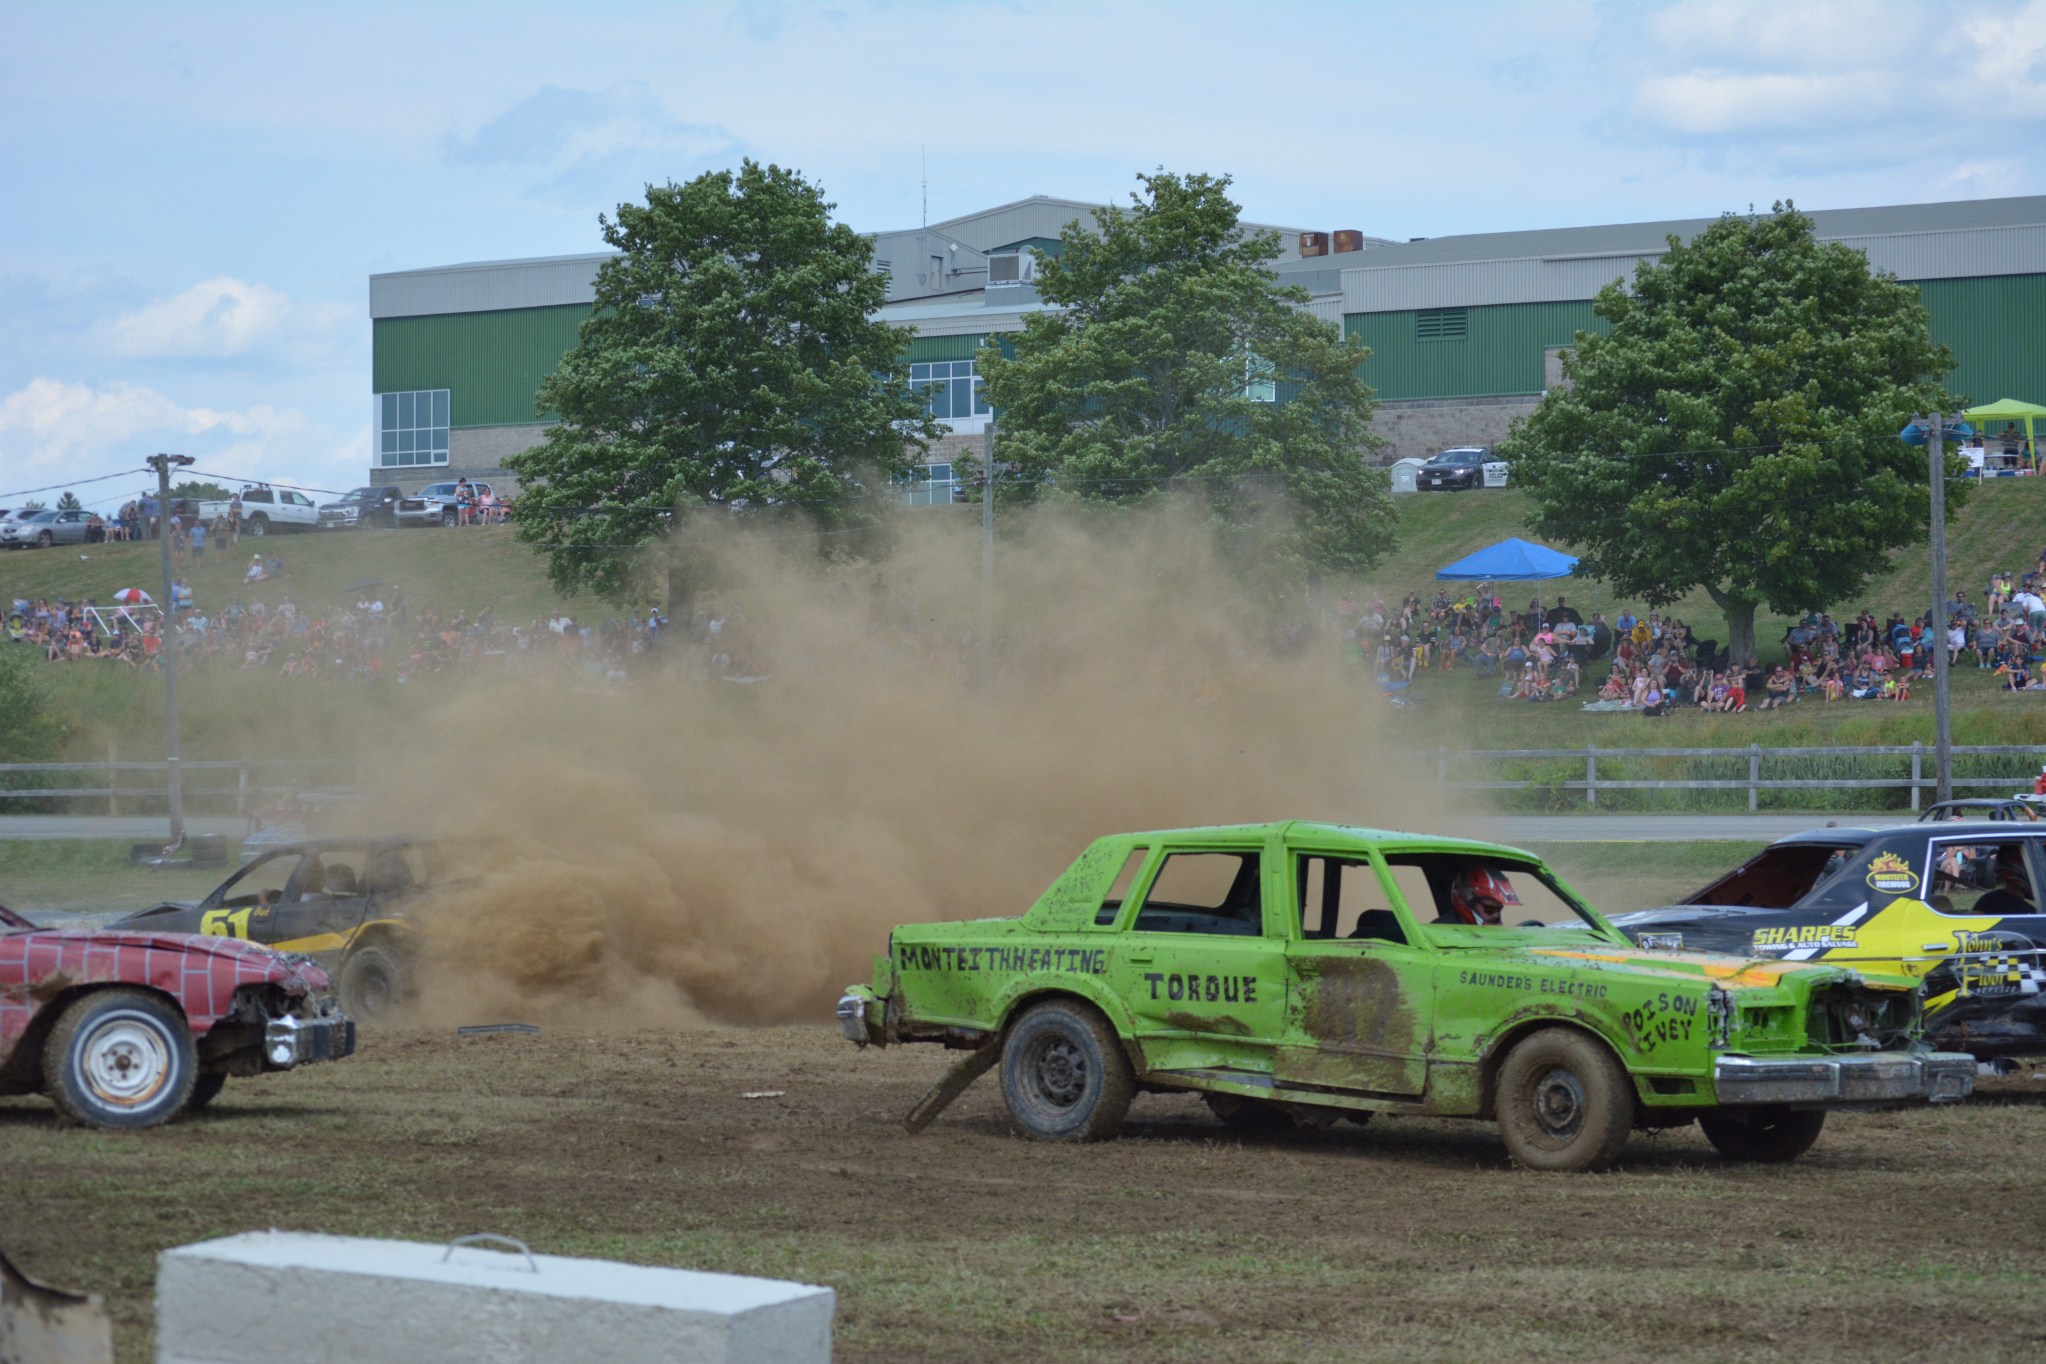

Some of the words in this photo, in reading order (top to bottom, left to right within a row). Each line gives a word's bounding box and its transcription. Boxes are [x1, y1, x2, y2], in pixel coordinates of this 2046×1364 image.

[200, 907, 253, 940] 51
[1753, 925, 1856, 945] SHARPES
[1753, 943, 1788, 951] TOWING
[1789, 941, 1796, 949] &
[1797, 941, 1820, 949] AUTO
[1821, 940, 1859, 948] SALVAGE
[1460, 971, 1532, 990] SAUNDERS
[1541, 978, 1607, 998] ELECTRIC
[1622, 993, 1697, 1031] POISON
[1643, 1017, 1692, 1052] IVEY
